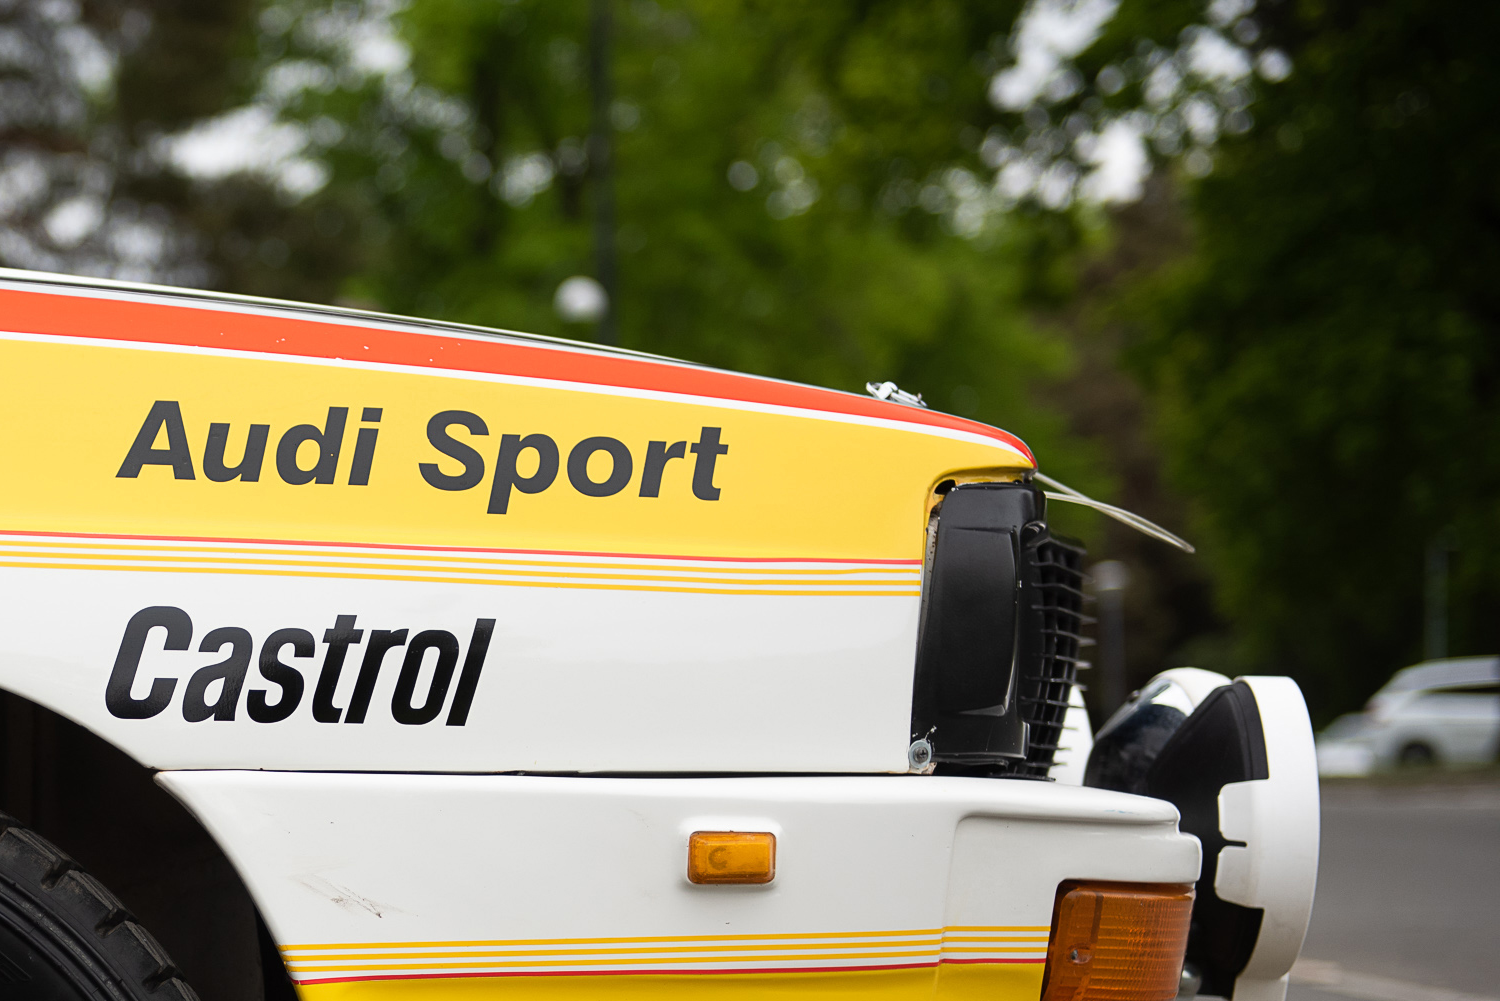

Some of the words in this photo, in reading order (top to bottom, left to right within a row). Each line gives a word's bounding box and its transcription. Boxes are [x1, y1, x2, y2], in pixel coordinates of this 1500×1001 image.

[115, 400, 384, 486] Audi
[418, 410, 729, 515] Sport
[104, 605, 497, 726] Castrol
